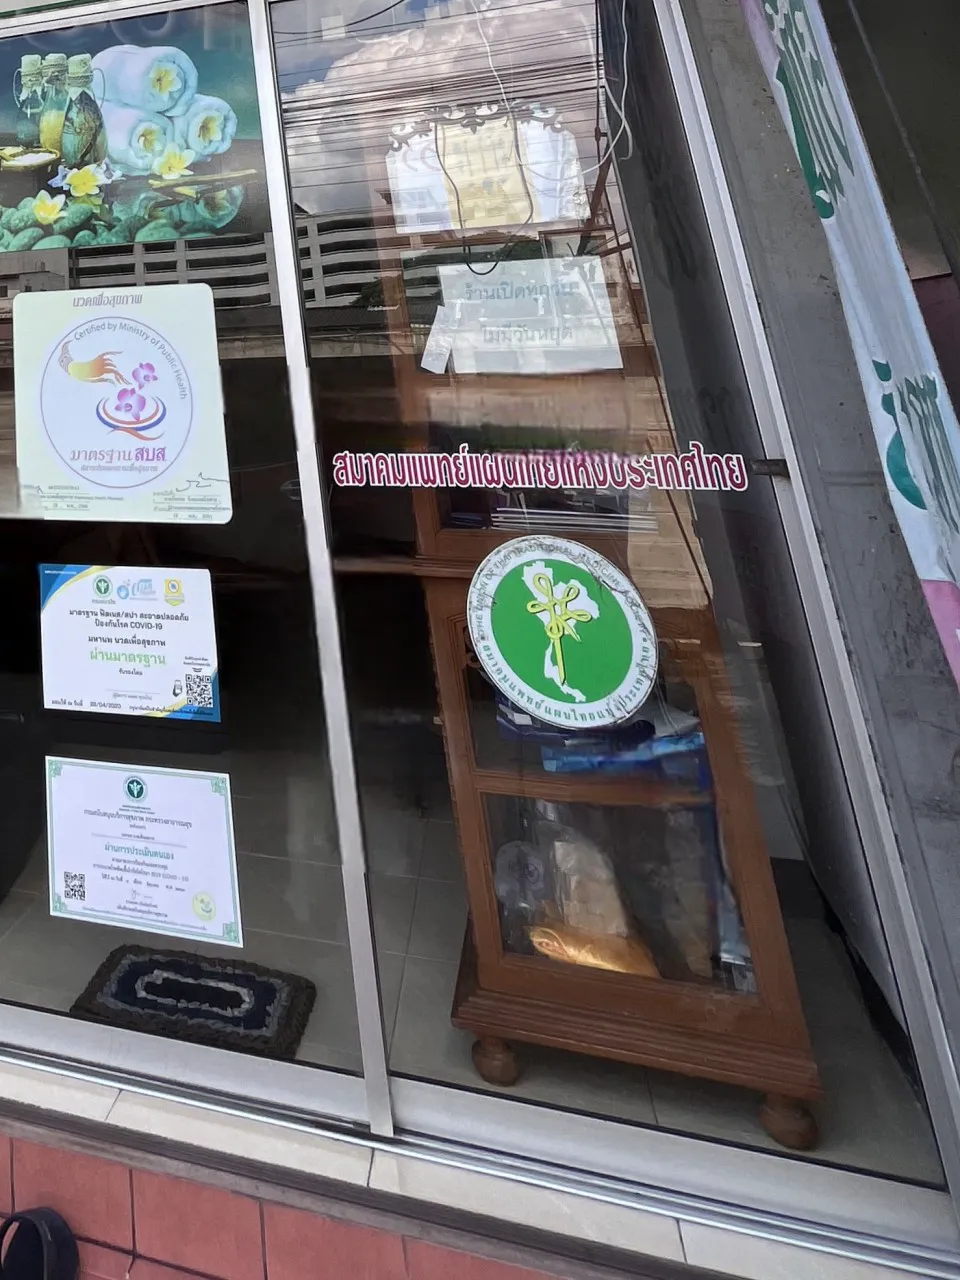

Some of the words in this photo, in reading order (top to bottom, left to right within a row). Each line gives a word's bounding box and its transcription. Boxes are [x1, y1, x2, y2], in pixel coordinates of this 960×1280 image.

[72, 292, 144, 309] นวดเพื่อสุขภาพ
[73, 322, 107, 341] Certified
[107, 322, 118, 332] by
[118, 322, 151, 345] Ministry
[150, 336, 160, 347] of
[157, 344, 178, 372] Public
[173, 369, 188, 401] Health
[70, 447, 133, 464] มาตรฐาน
[134, 445, 168, 463] สบส
[332, 441, 748, 491] สมาคมแพทย์แผนไทยแหงประเทศไทย
[130, 622, 163, 631] COVID-19
[90, 647, 166, 668] ผ่านมาตรฐาน
